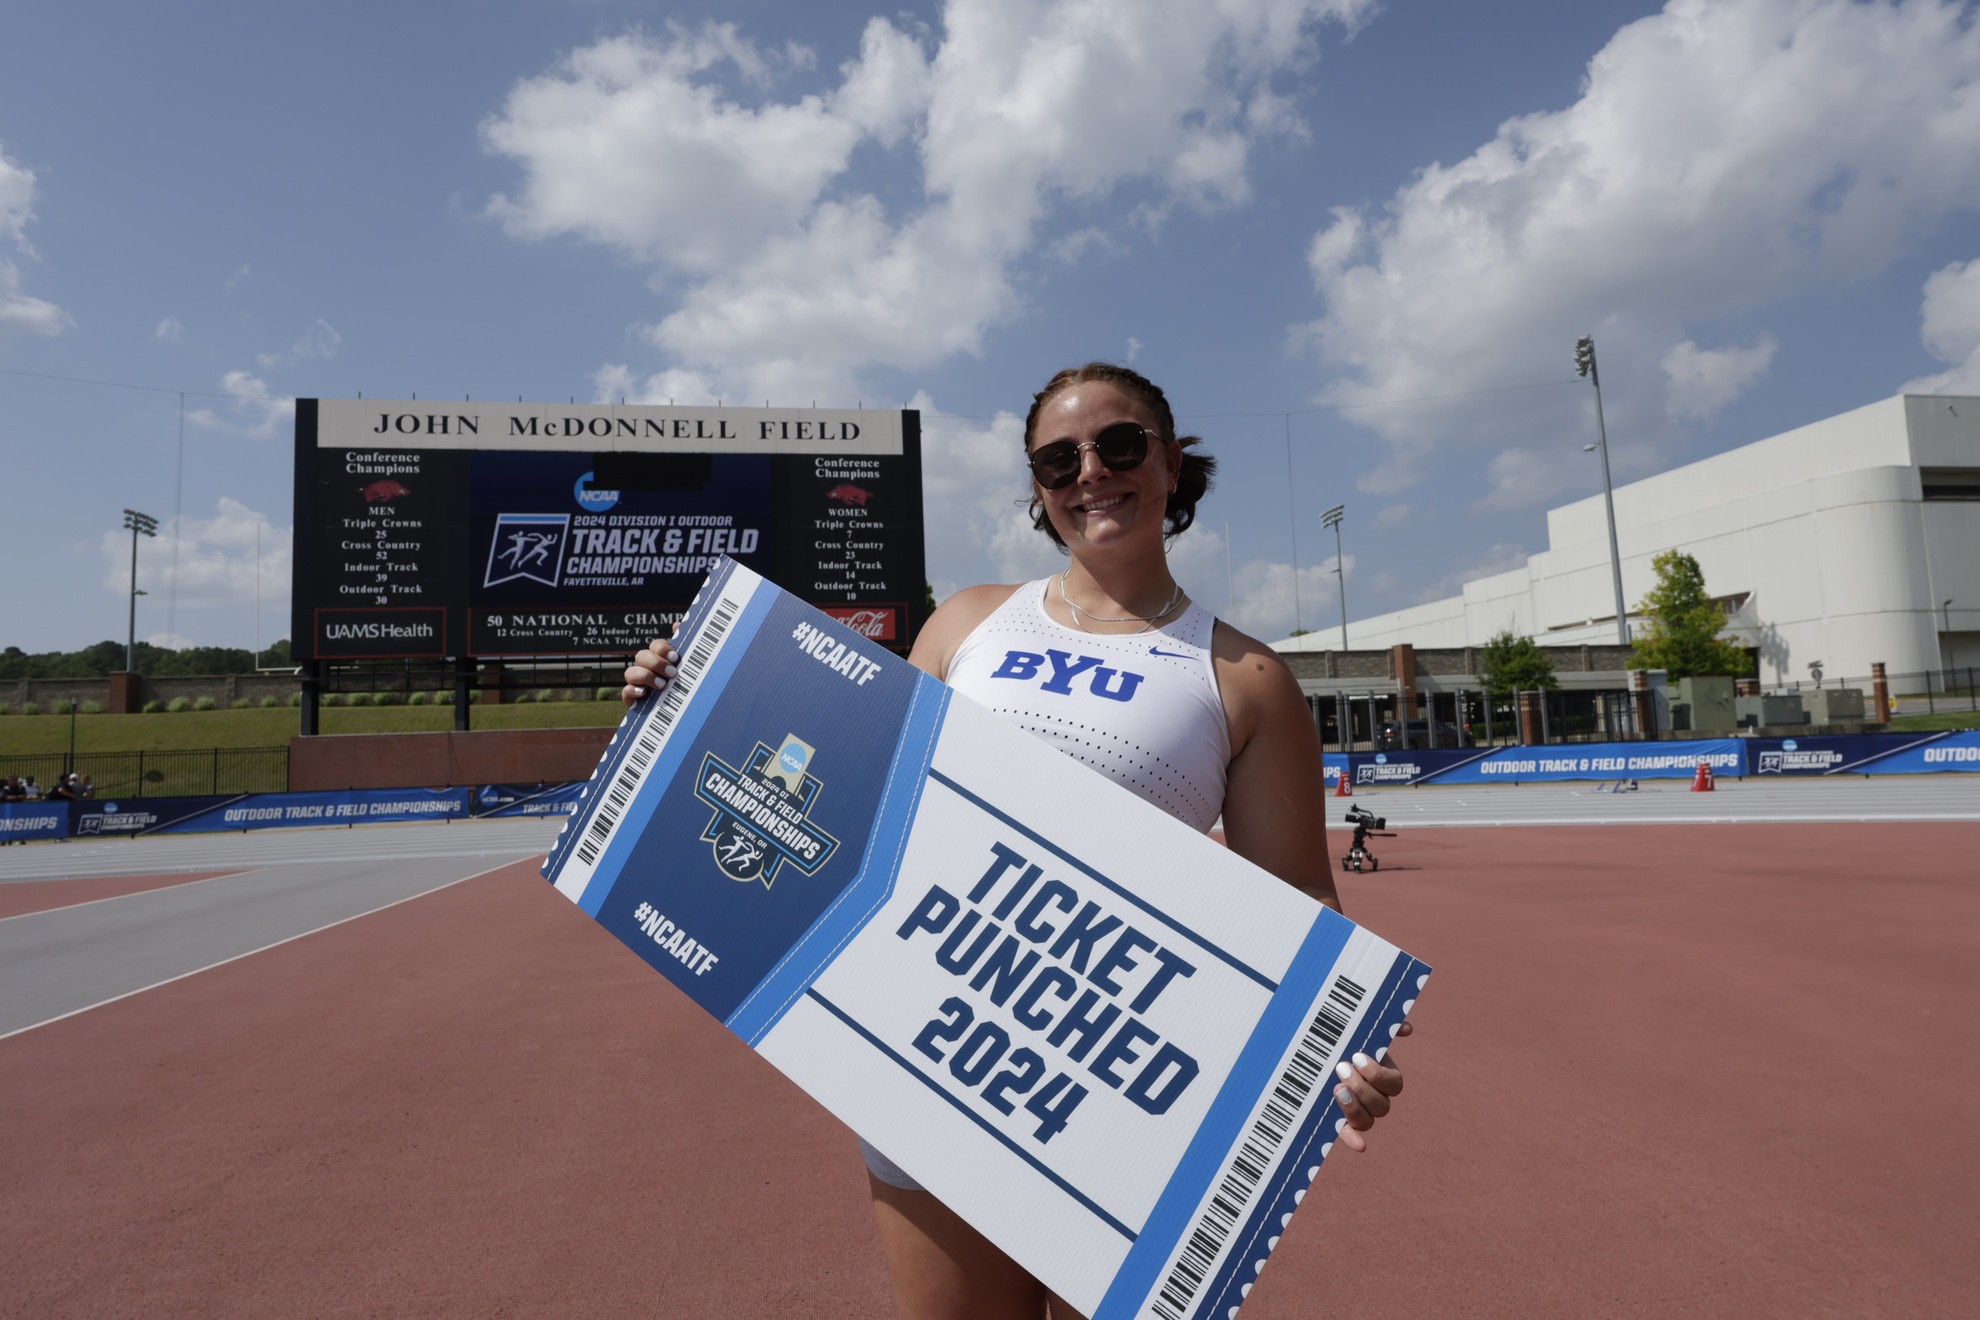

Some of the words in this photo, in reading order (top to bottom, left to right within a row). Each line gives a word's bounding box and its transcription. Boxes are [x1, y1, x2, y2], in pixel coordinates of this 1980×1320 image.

[373, 413, 480, 435] JOHN
[508, 416, 737, 440] McDONNELL
[758, 421, 860, 441] FIELD
[346, 452, 420, 463] Conference
[815, 458, 880, 468] Conference
[346, 463, 420, 475] Champions
[815, 468, 880, 480] Champions
[578, 490, 620, 502] NCAA
[368, 506, 395, 516] MEN
[828, 508, 868, 517] WOMEN
[342, 518, 376, 530] Triple
[382, 518, 422, 528] Crowns
[573, 515, 606, 527] 2024
[608, 515, 667, 527] DIVISION
[669, 515, 676, 527] I
[678, 515, 733, 527] OUTDOOR
[814, 520, 844, 530] Triple
[848, 520, 884, 529] Crowns
[375, 530, 387, 539] 25
[846, 531, 852, 539] 7
[341, 540, 373, 550] Cross
[377, 540, 422, 551] Country
[572, 528, 662, 554] TRACK
[663, 528, 683, 554] &
[686, 528, 760, 554] FIELD
[815, 541, 842, 550] Cross
[846, 541, 884, 551] Country
[375, 551, 388, 560] 52
[845, 551, 856, 560] 23
[344, 562, 382, 572] Indoor
[386, 562, 419, 572] Track
[566, 556, 718, 574] CHAMPIONSHIPS
[818, 561, 850, 570] Indoor
[853, 561, 882, 570] Track
[375, 573, 388, 582] 39
[845, 571, 855, 579] 14
[563, 577, 630, 587] FAYETTEVILLE,
[630, 577, 645, 587] AR
[814, 581, 854, 591] Outdoor
[858, 581, 887, 591] Track
[339, 584, 386, 594] Outdoor
[390, 584, 423, 594] Track
[375, 596, 388, 605] 30
[846, 592, 856, 600] 10
[487, 615, 503, 627] 50
[512, 614, 608, 626] NATIONAL
[497, 628, 507, 637] 12
[510, 628, 534, 637] Cross
[538, 628, 574, 638] Country
[586, 627, 598, 635] 26
[602, 627, 631, 635] Indoor
[635, 627, 659, 635] Track
[572, 637, 579, 645] 7
[582, 637, 610, 645] NCAA
[615, 636, 641, 646] Triple
[792, 621, 882, 686] #NCAATF
[990, 648, 1145, 702] BYU
[1924, 747, 1980, 762] OUTDO
[781, 753, 803, 771] NCAA
[1481, 761, 1536, 774] OUTDOOR
[1539, 759, 1578, 772] TRACK
[1579, 758, 1589, 771] &
[1591, 757, 1626, 771] FIELD
[1628, 753, 1739, 770] CHAMPIONSHIPS
[761, 778, 780, 794] 2024
[779, 789, 790, 800] DI
[1343, 781, 1352, 794] 8
[737, 773, 766, 803] TRACK
[767, 795, 777, 807] &
[774, 801, 803, 825] FIELD
[224, 807, 282, 822] OUTDOOR
[285, 805, 324, 819] TRACK
[325, 804, 334, 817] &
[336, 803, 368, 816] FIELD
[370, 800, 461, 815] CHAMPIONSHIPS
[523, 803, 551, 814] TRACK
[552, 803, 560, 812] &
[705, 772, 821, 860] CHAMPIONSHIPS
[757, 838, 768, 850] OR
[966, 841, 1198, 1015] TICKET
[634, 901, 719, 976] #NCAATF
[895, 884, 1200, 1115] PUNCHED
[911, 996, 1089, 1145] 2024
